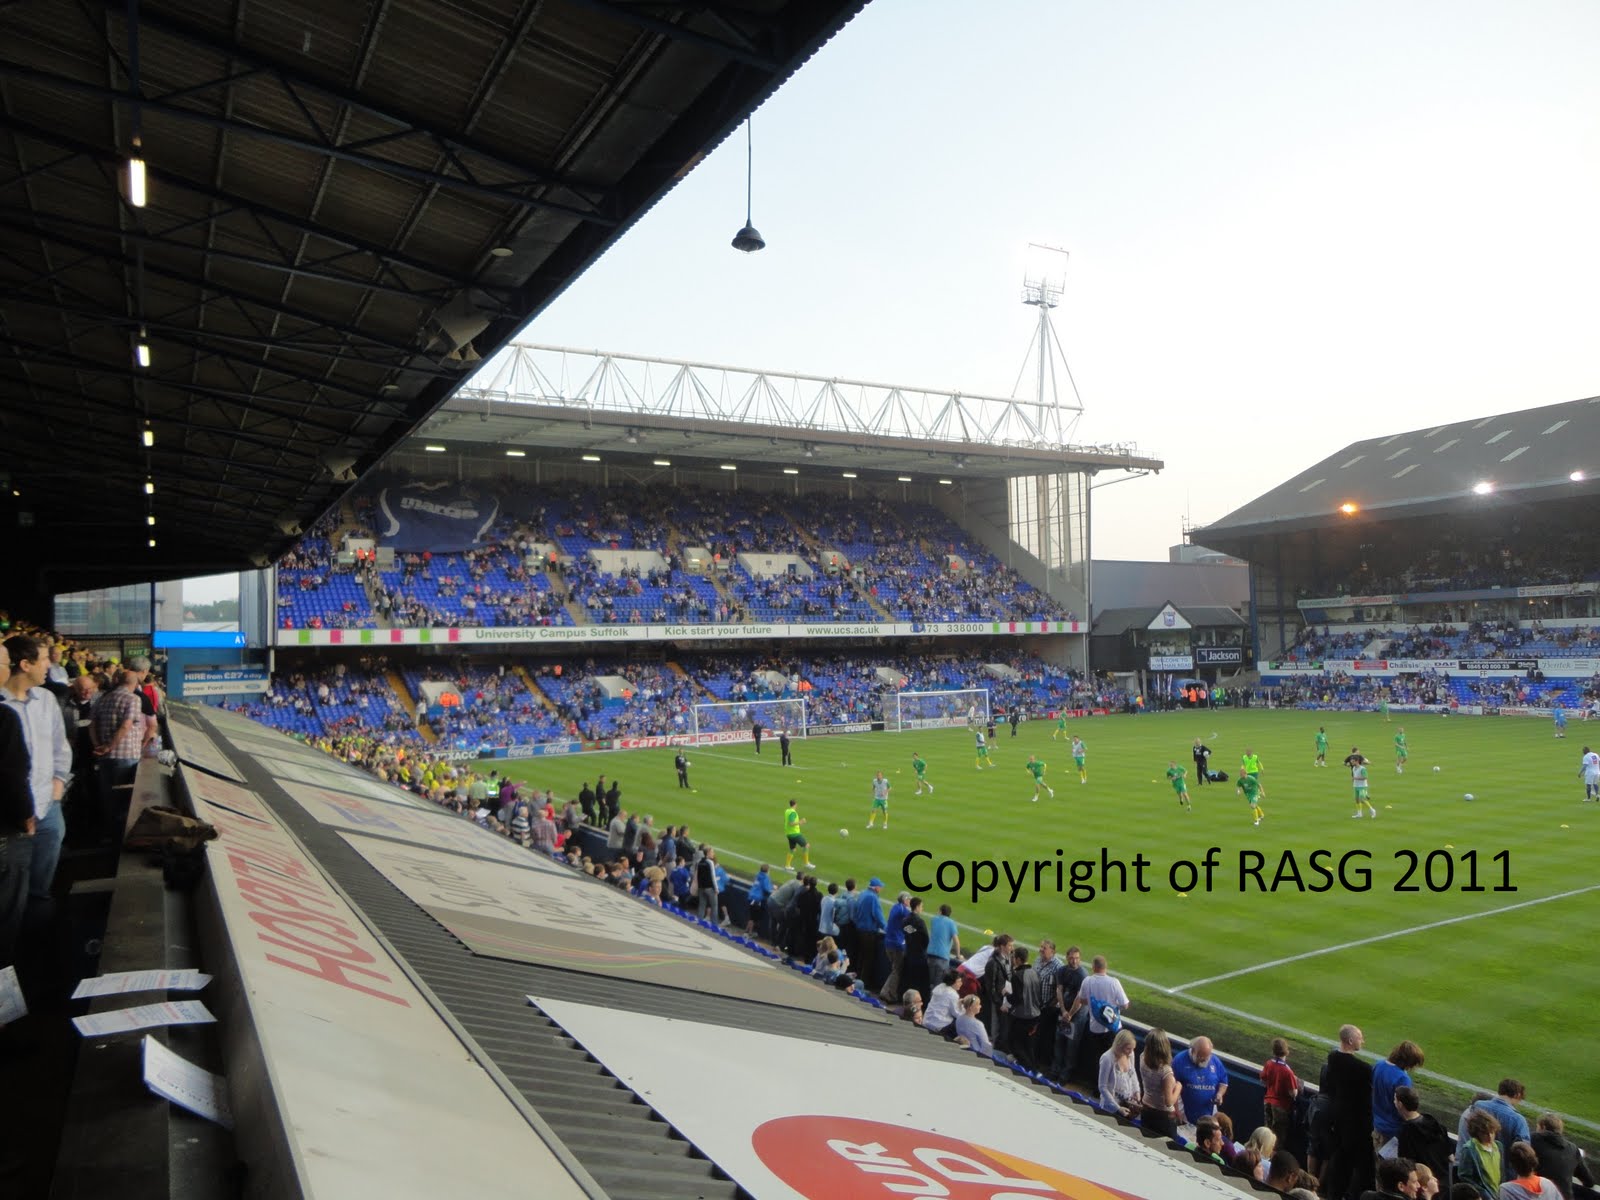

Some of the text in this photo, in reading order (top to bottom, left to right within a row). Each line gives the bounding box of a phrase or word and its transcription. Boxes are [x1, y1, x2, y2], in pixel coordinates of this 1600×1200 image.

[664, 626, 772, 636] Kick start your future
[806, 625, 880, 635] www.ucs.ac.uk
[947, 624, 984, 633] 338000
[475, 628, 629, 640] University Campus Suffolk
[1208, 651, 1240, 661] Jackson
[808, 725, 871, 736] marcusevans
[507, 885, 625, 936] New
[562, 885, 713, 951] College
